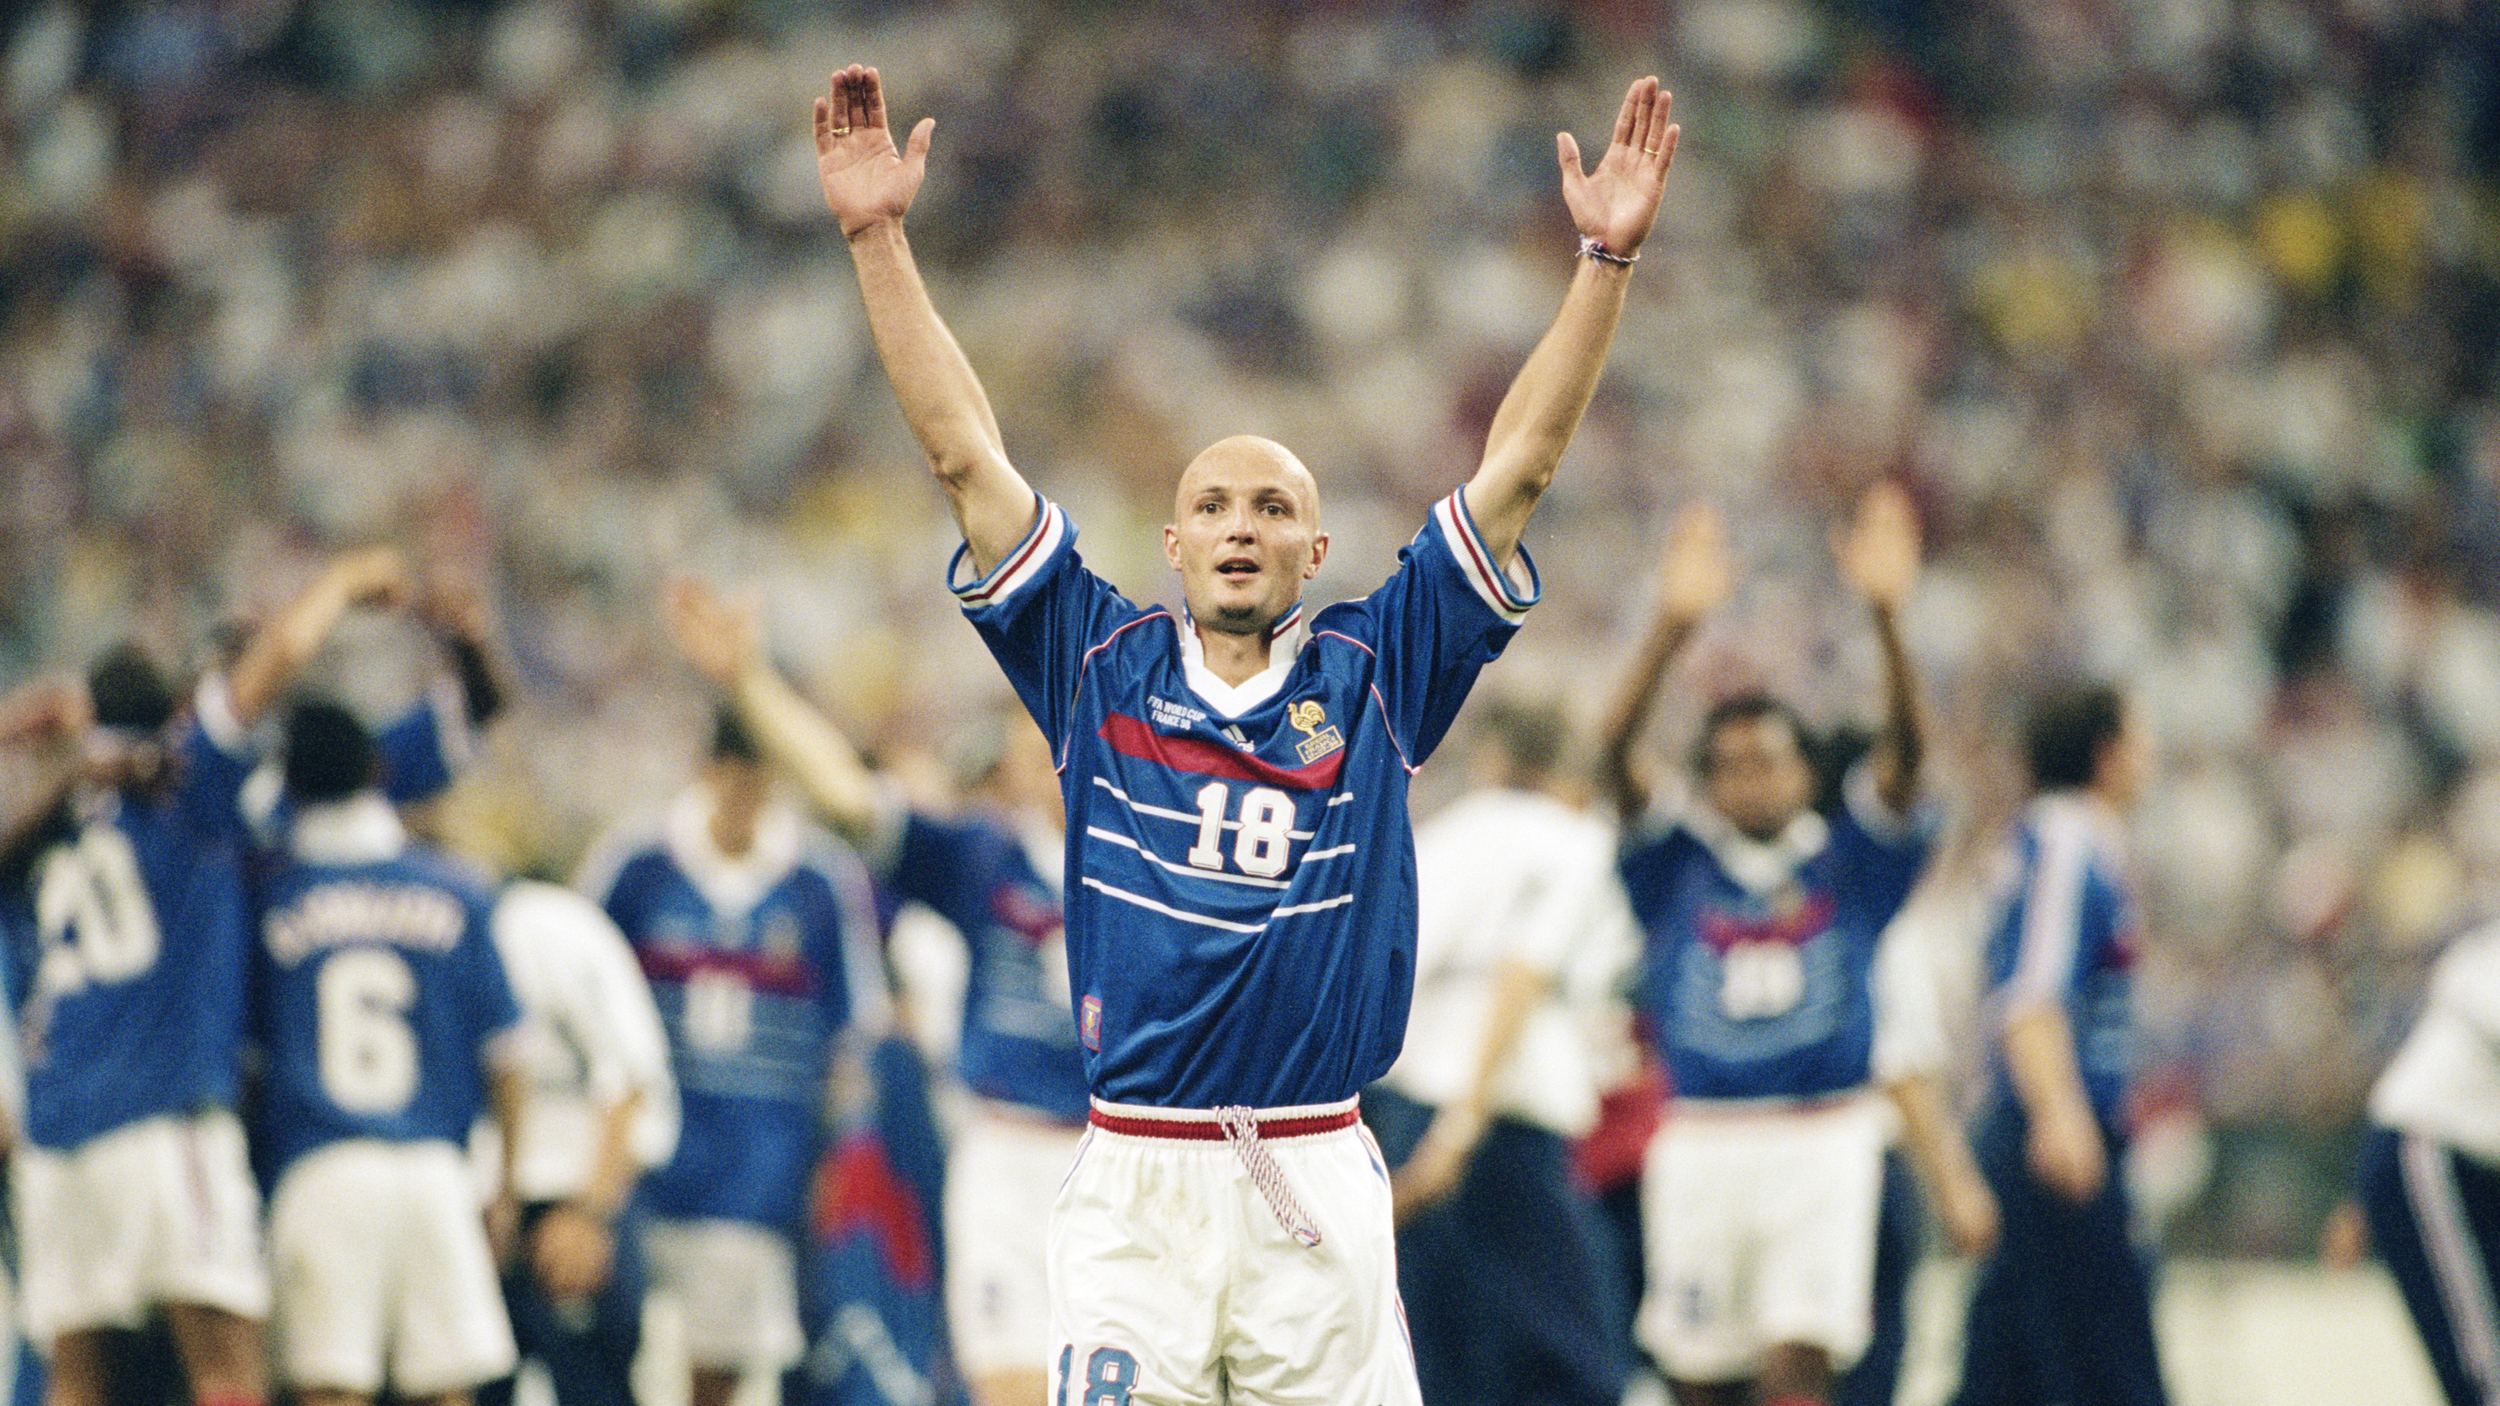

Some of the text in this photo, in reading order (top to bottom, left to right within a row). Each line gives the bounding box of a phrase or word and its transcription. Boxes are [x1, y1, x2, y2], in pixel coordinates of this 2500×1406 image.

[1151, 709, 1192, 730] FRANCE 98
[1163, 701, 1188, 717] WORLD
[1187, 708, 1207, 722] CUP
[1188, 782, 1296, 877] 18
[315, 946, 419, 1114] 6
[1057, 1343, 1141, 1406] 18
